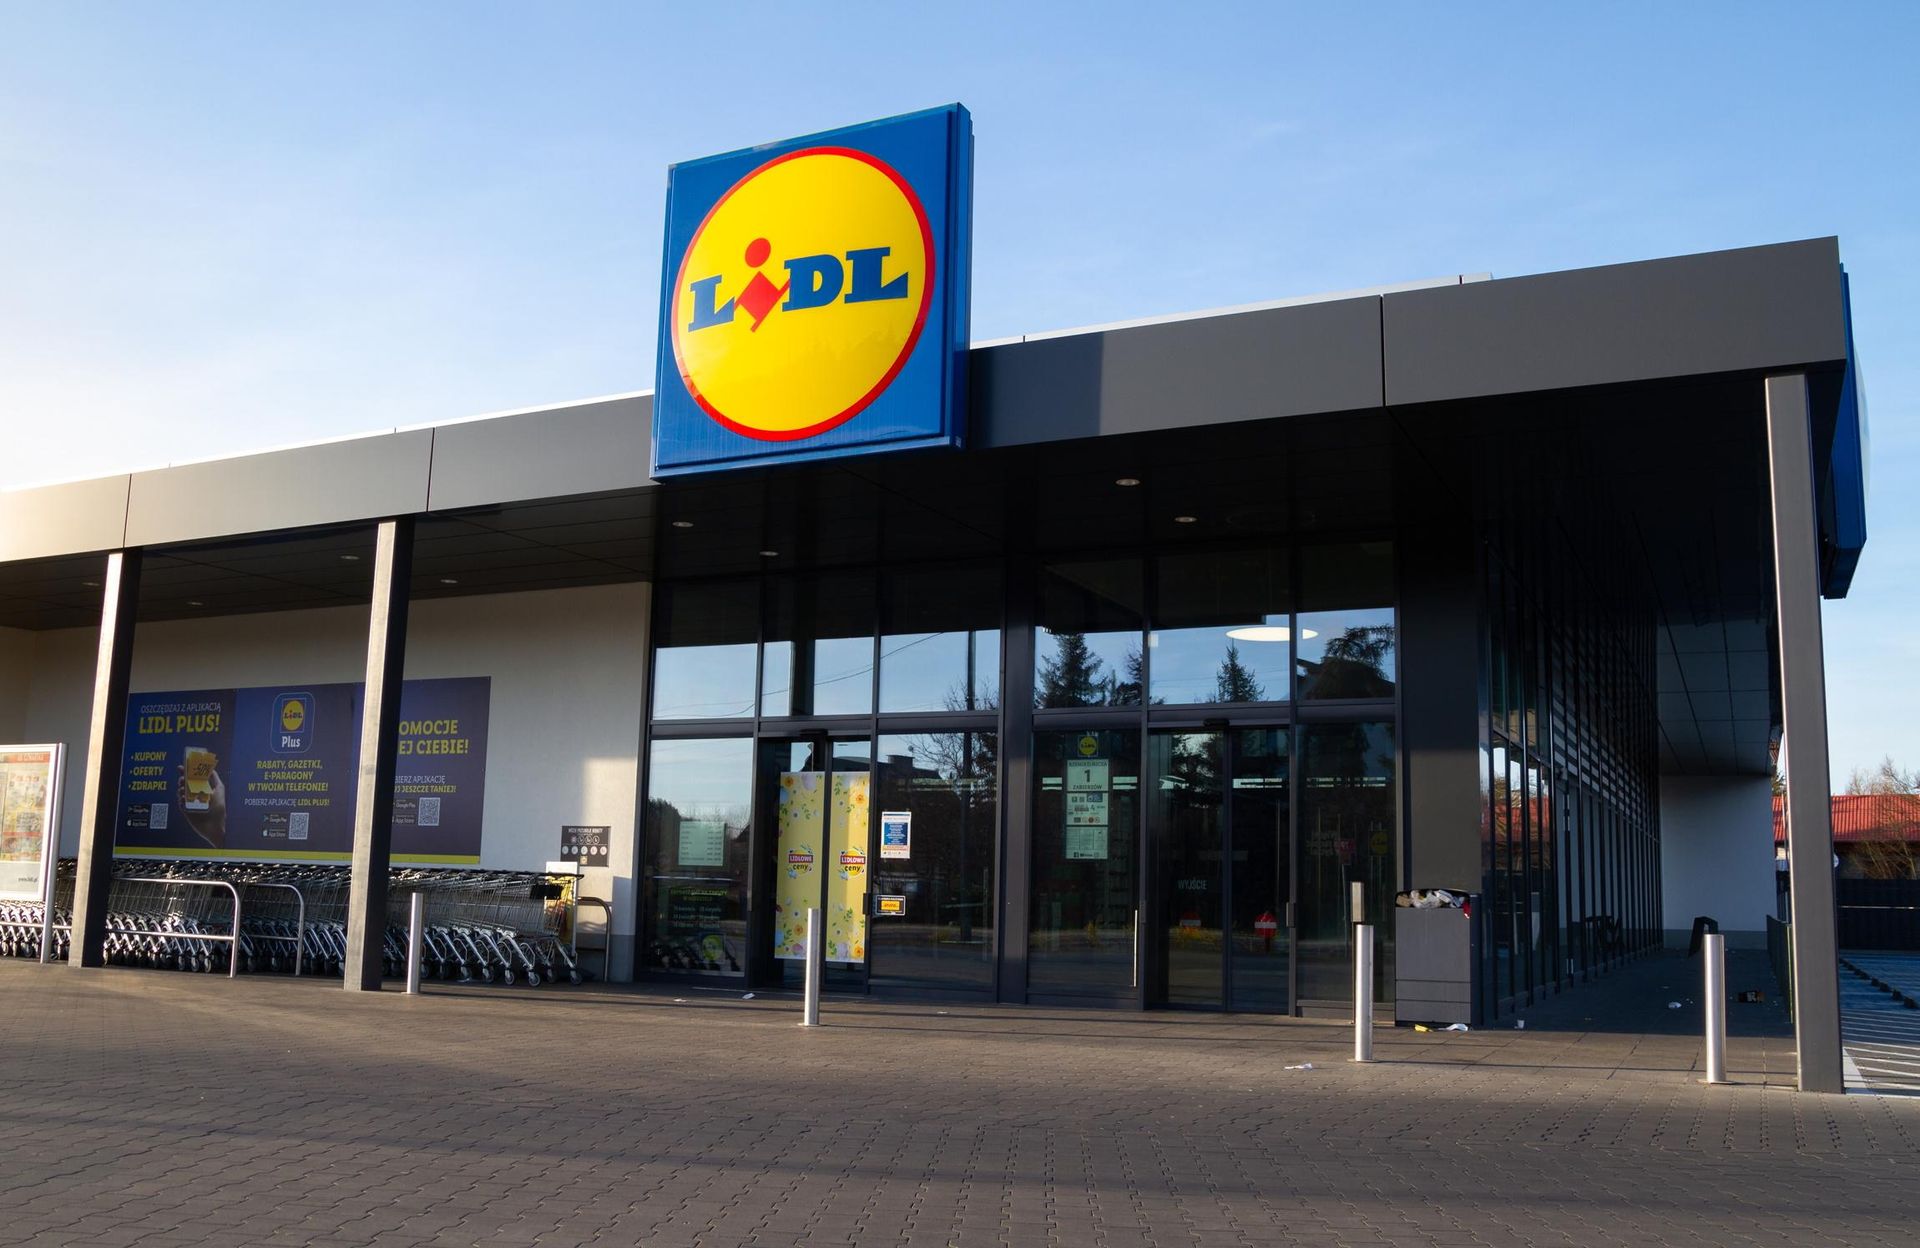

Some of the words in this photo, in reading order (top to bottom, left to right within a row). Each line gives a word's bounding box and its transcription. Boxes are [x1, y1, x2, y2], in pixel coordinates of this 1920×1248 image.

[187, 702, 221, 713] APLIKACJĄ
[139, 715, 173, 734] LIDL
[176, 714, 220, 732] PLUS!
[399, 720, 458, 736] OMOCJE
[281, 736, 301, 748] Plus
[416, 739, 469, 754] CIEBIE!
[134, 752, 167, 761] KUPONY
[256, 760, 287, 770] RABATY,
[287, 760, 323, 769] GAZETKI,
[133, 766, 164, 776] OFERTY
[264, 771, 314, 780] E-PARAGONY
[1084, 769, 1090, 782] 1
[131, 781, 167, 791] ZDRAPKI
[248, 782, 256, 791] W
[257, 782, 285, 791] TWOIM
[286, 782, 329, 791] TELEFONIE!
[297, 798, 312, 806] LIDL
[792, 863, 808, 871] ceny
[1178, 878, 1207, 889] WYJŚCIE
